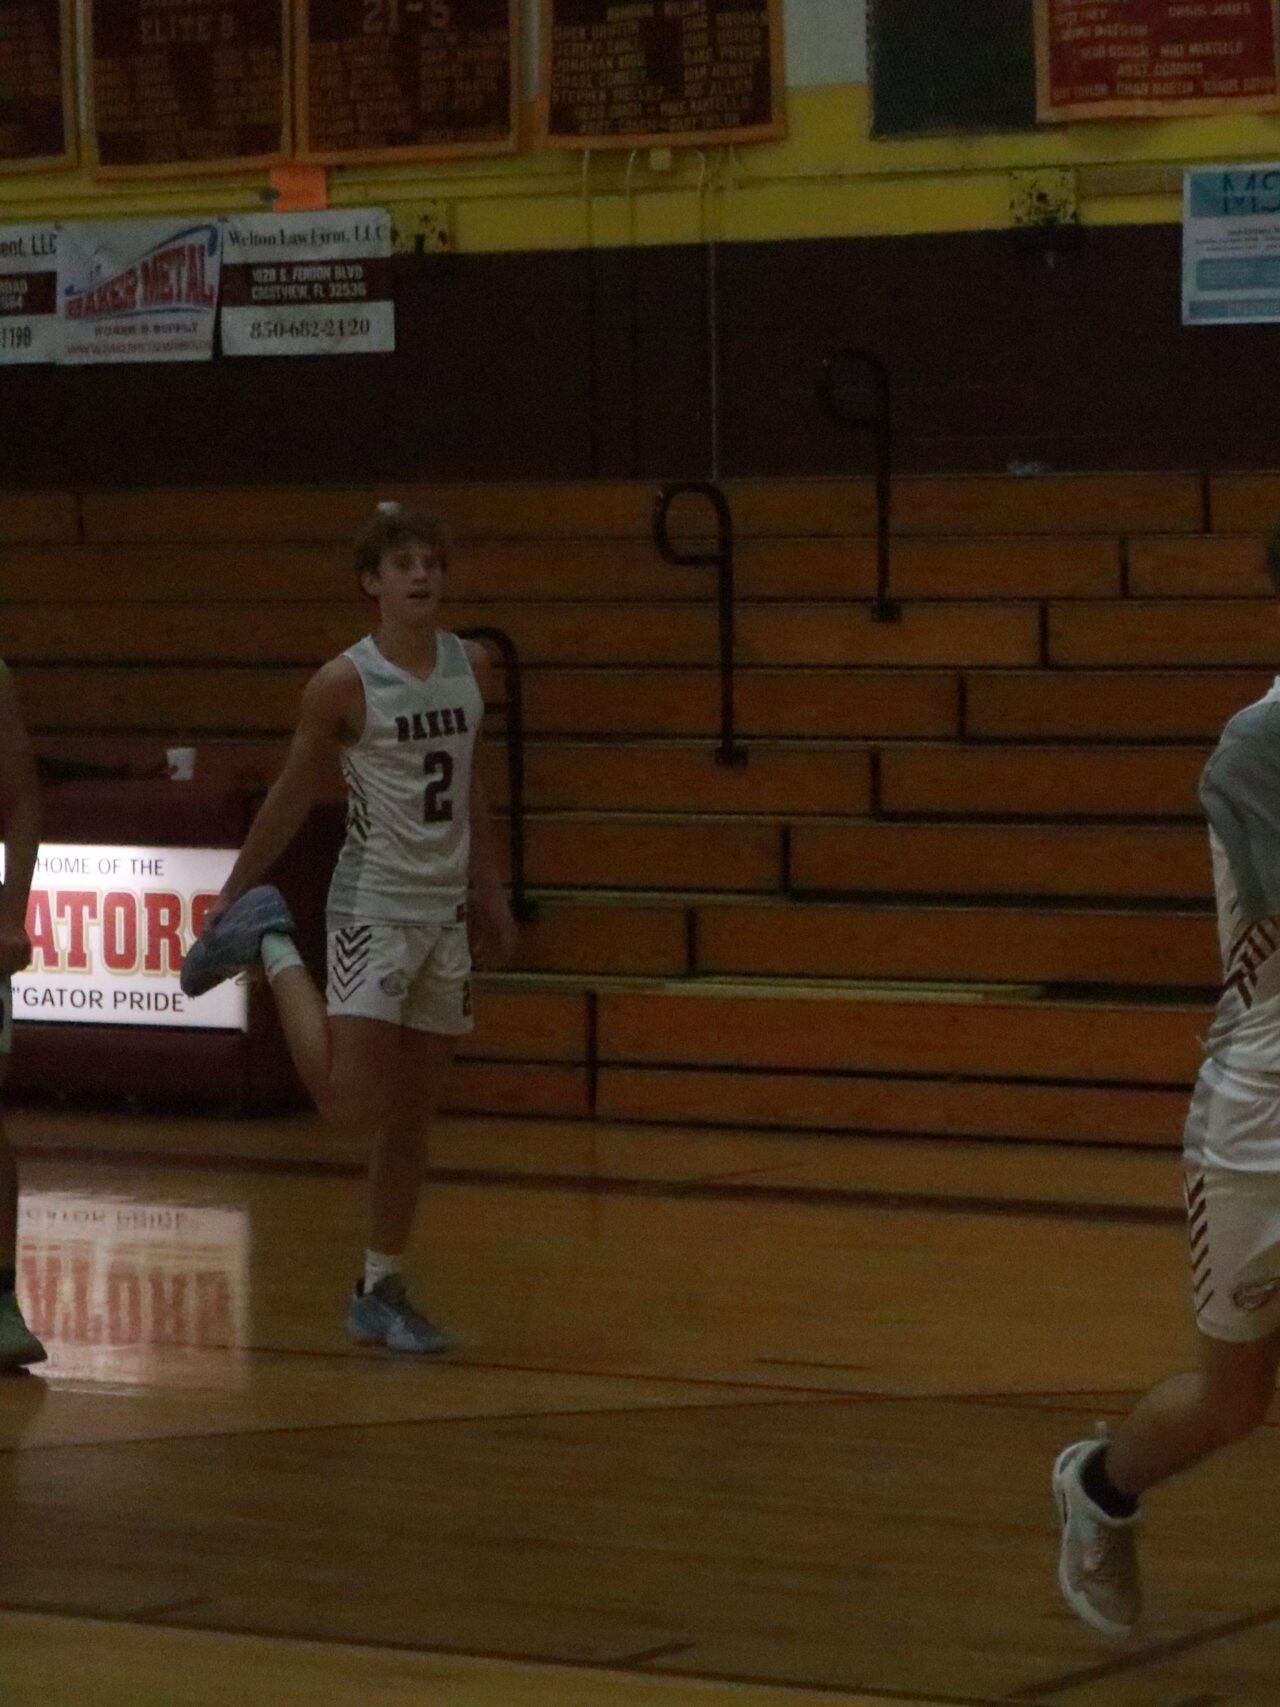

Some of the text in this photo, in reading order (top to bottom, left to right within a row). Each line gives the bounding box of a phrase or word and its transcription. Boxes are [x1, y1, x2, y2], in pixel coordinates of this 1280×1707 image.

[1210, 2, 1252, 16] JONES
[31, 234, 57, 256] LLC
[228, 231, 277, 247] Welton
[279, 228, 307, 246] Law
[140, 243, 215, 307] METAL
[334, 264, 364, 280] BLVD
[250, 317, 371, 341] 850-682-2120
[395, 706, 468, 743] BAKER
[423, 750, 453, 822] 2
[37, 858, 164, 877] HOME OF THE
